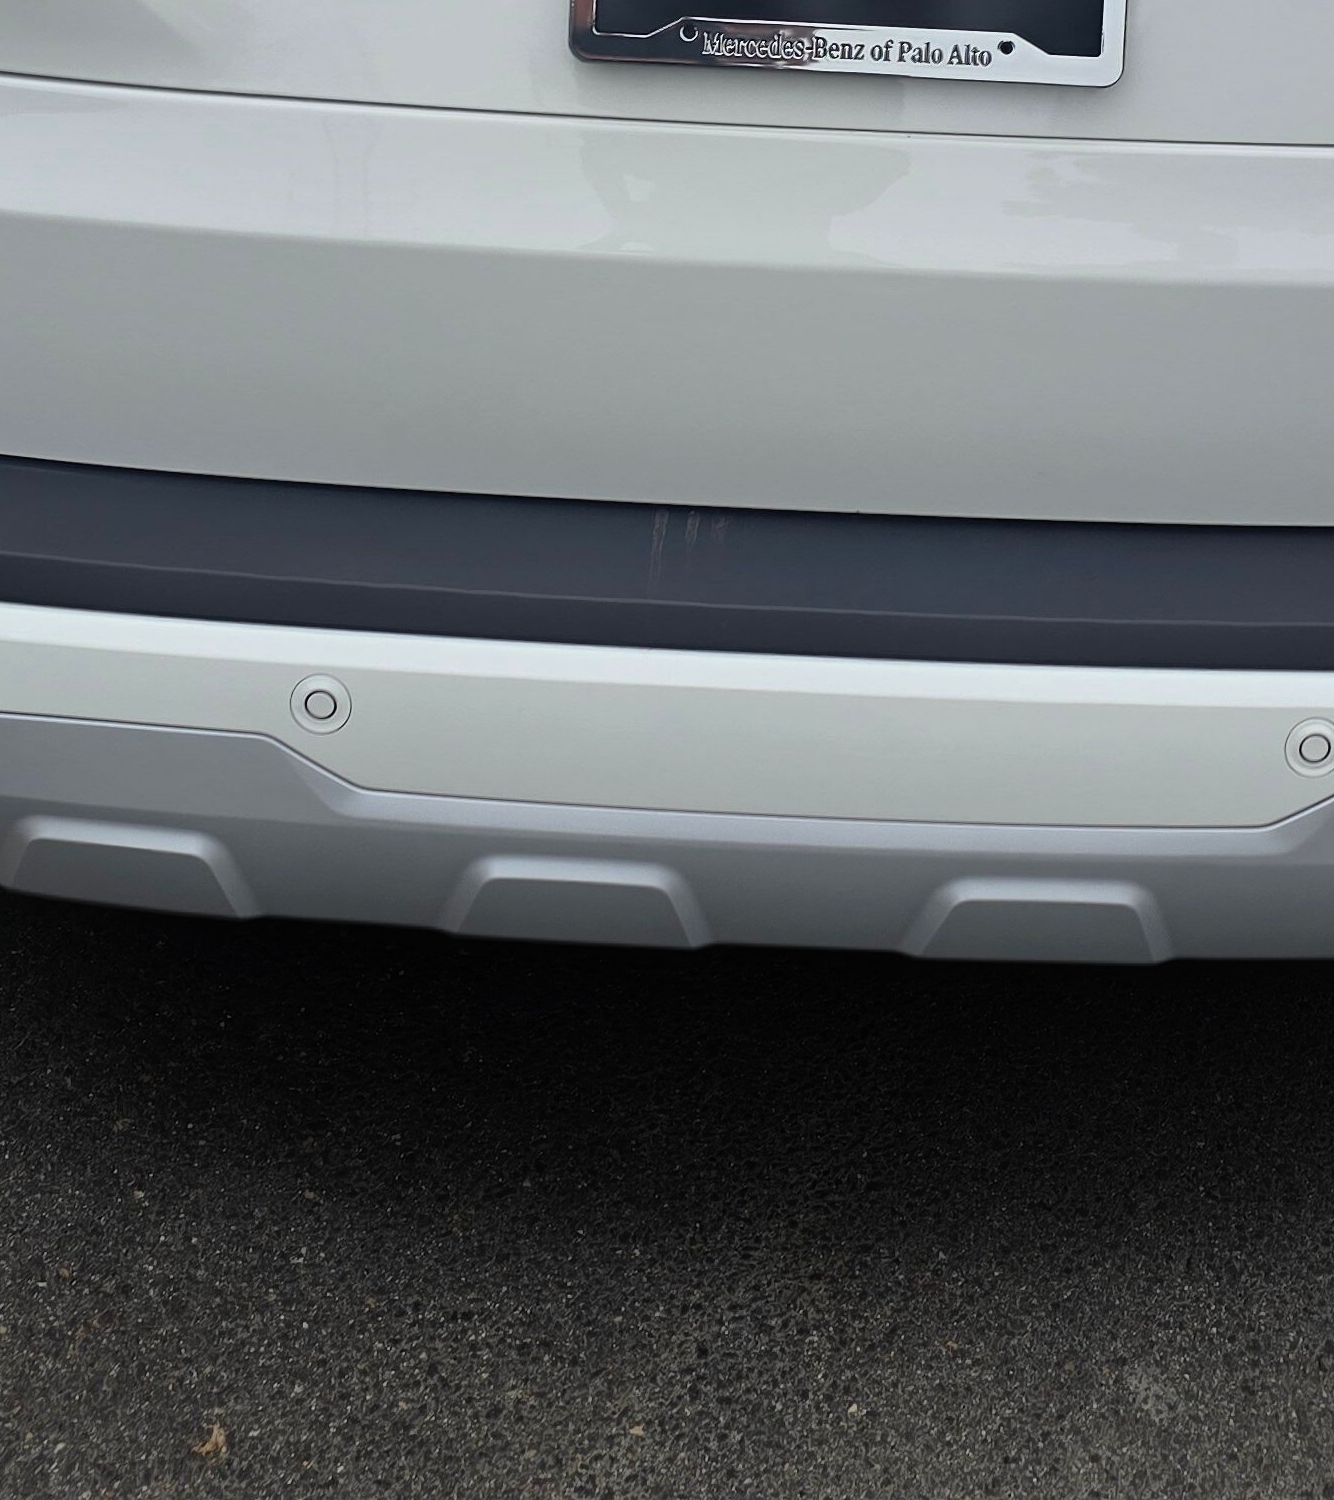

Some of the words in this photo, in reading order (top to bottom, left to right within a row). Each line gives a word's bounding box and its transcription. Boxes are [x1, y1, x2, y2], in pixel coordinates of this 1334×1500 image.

[702, 31, 865, 61] Mercedes-Benz
[870, 39, 895, 62] of
[897, 42, 943, 66] Palo
[946, 44, 993, 67] Alto
